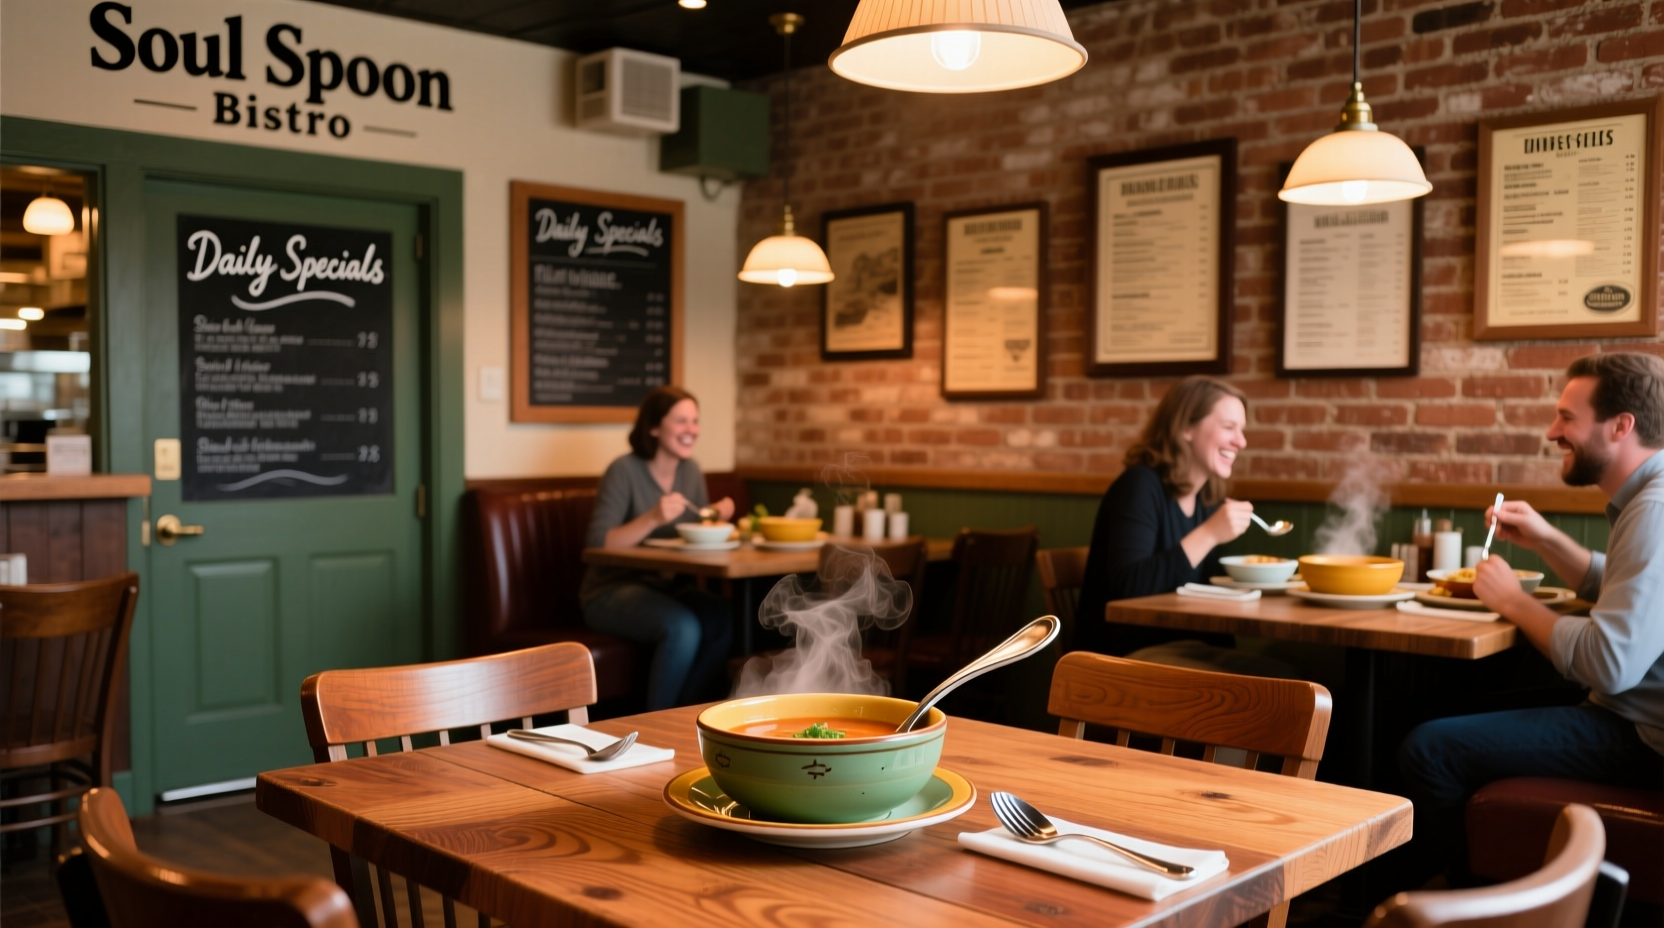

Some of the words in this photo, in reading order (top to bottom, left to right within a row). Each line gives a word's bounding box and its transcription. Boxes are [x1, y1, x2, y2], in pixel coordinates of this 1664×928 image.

[89, 1, 247, 81] Soul
[265, 23, 454, 112] Spoon
[213, 92, 351, 139] Bistro
[534, 208, 589, 258] Daily
[594, 210, 664, 254] Specials
[186, 229, 278, 297] Daily
[279, 233, 385, 292] Specials
